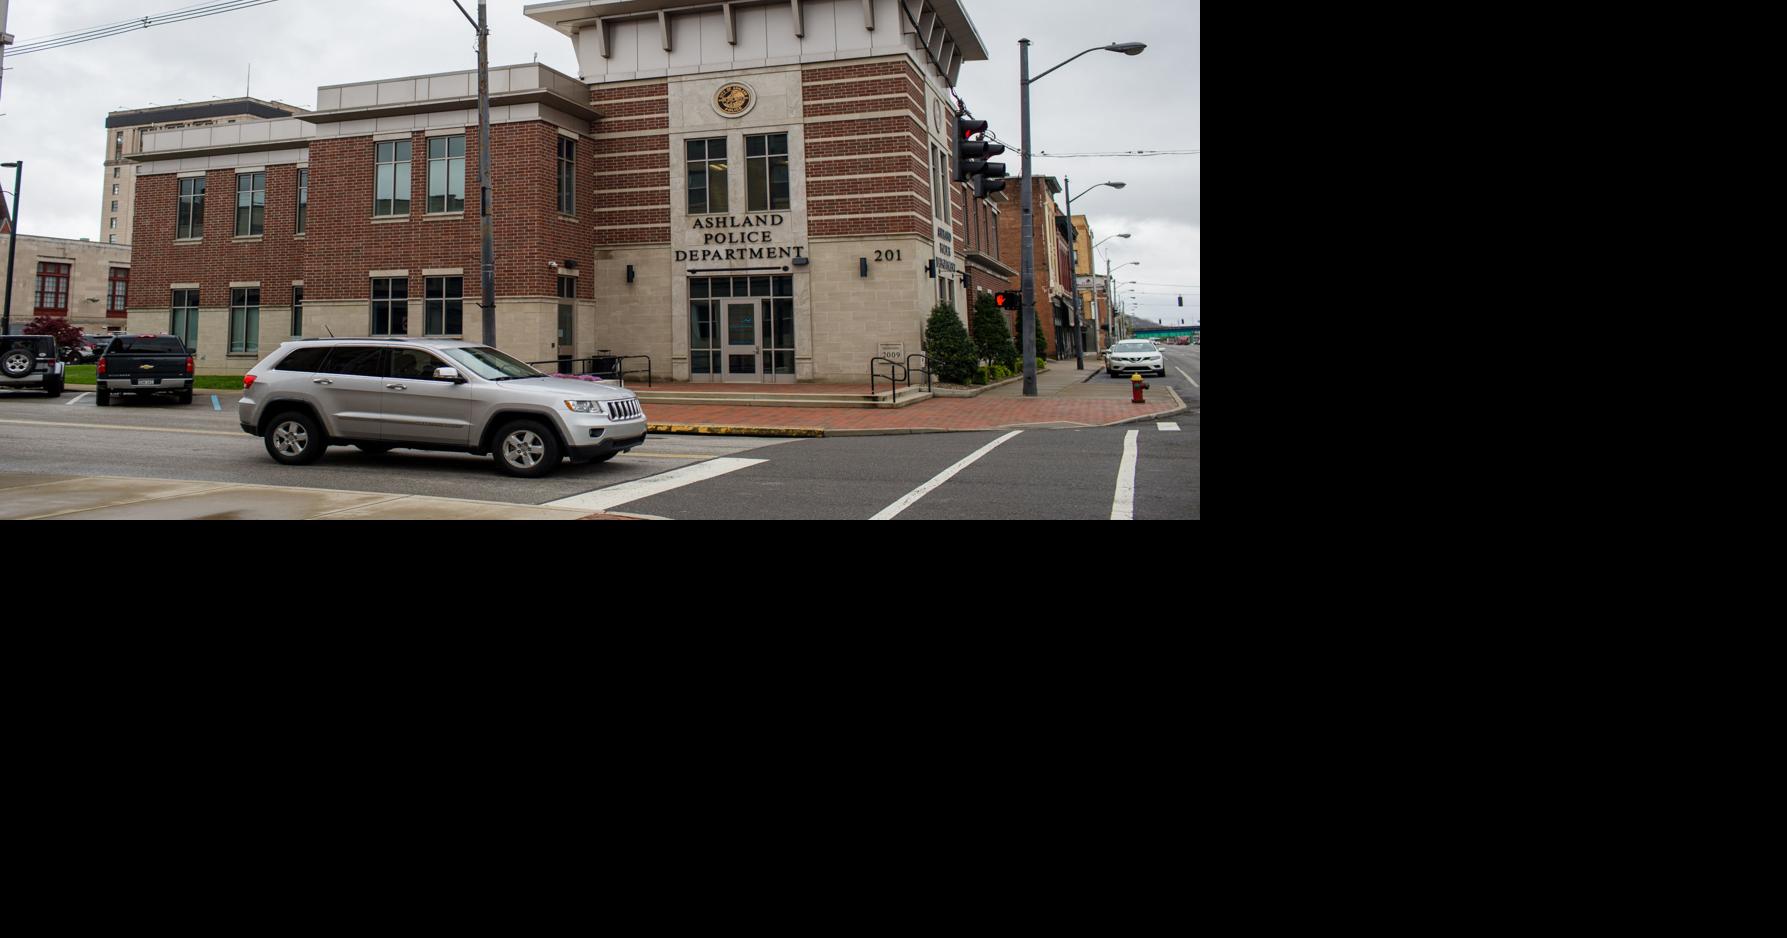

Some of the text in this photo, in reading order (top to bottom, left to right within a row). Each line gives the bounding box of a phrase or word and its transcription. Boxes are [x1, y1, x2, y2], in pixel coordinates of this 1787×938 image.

[692, 214, 784, 229] ASHLAND
[704, 231, 773, 245] POLICE
[675, 246, 804, 262] DEPARTMENT
[874, 249, 903, 262] 201
